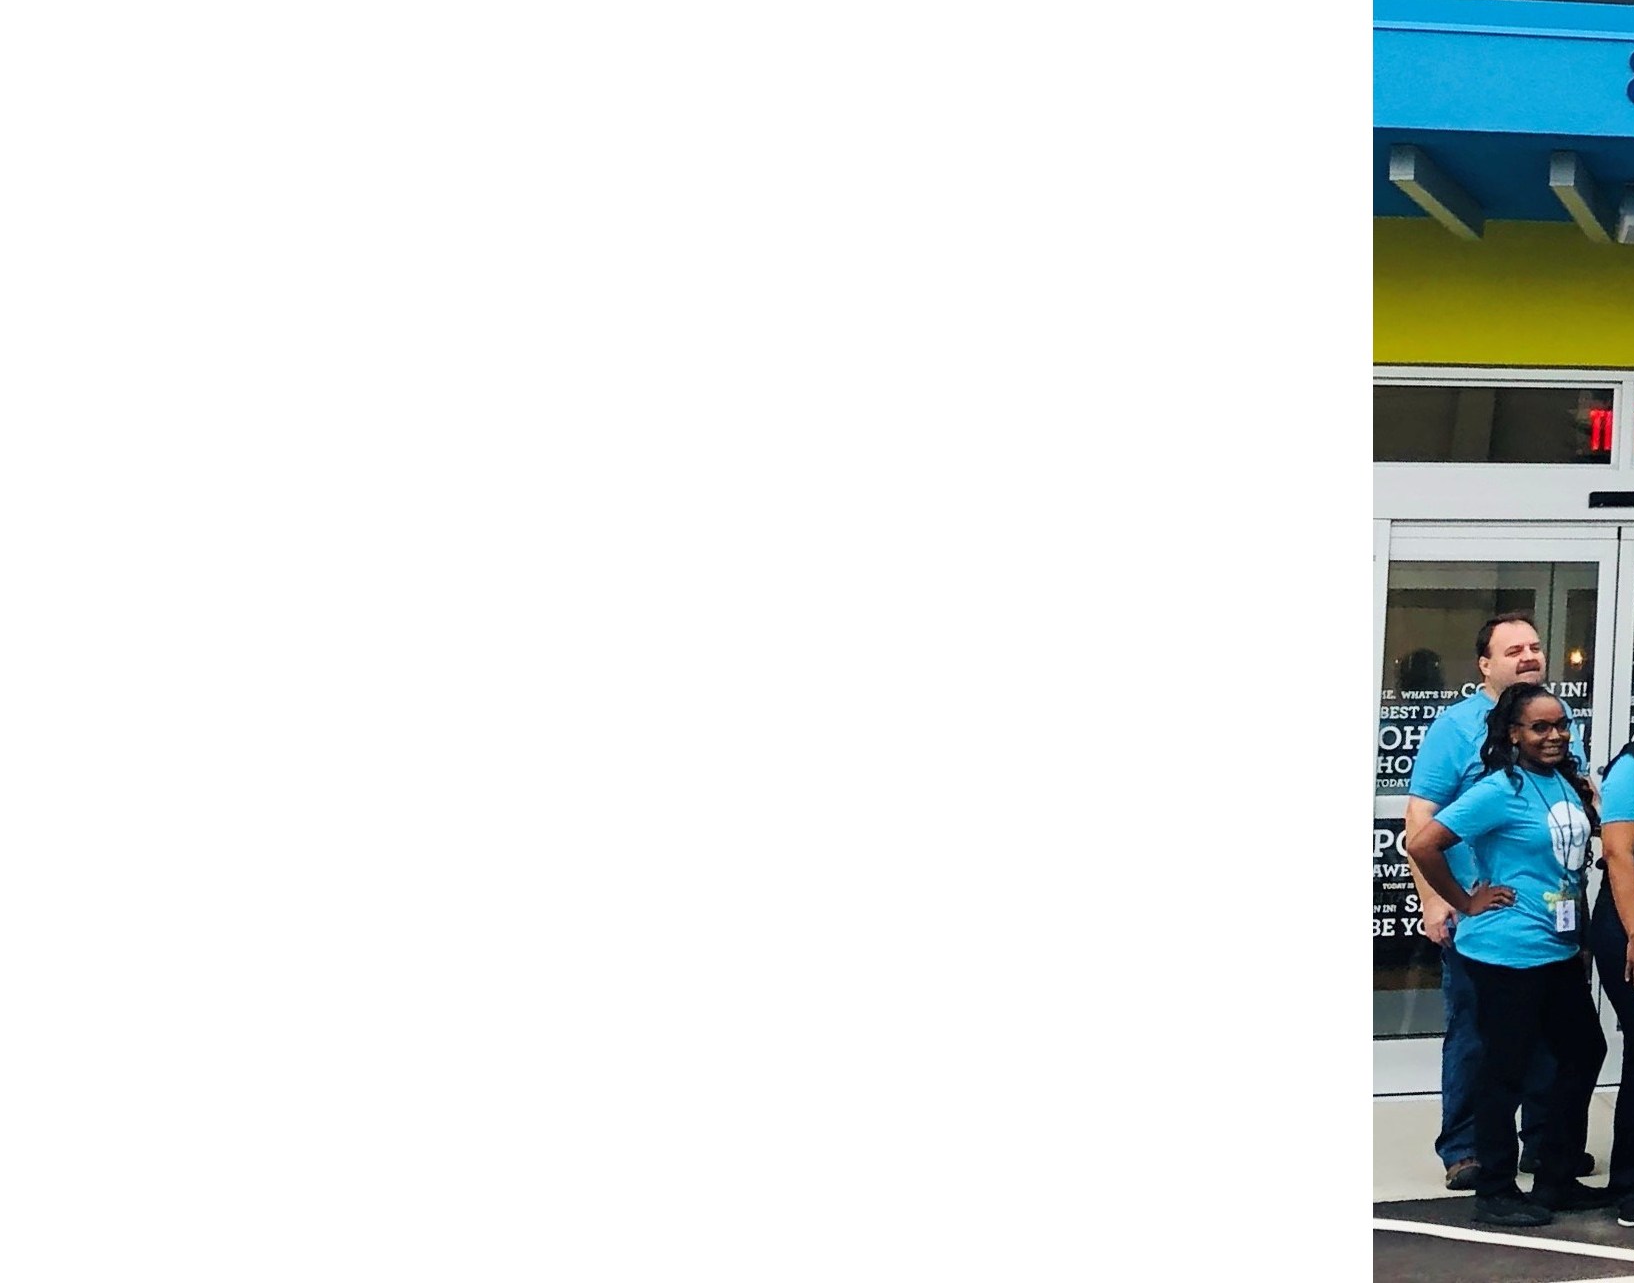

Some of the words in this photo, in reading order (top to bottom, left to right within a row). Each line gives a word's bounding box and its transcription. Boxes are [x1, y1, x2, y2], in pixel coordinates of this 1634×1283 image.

[1401, 690, 1439, 699] WHAT'S
[1441, 690, 1458, 699] UP?
[1559, 681, 1588, 697] IN!
[1380, 705, 1421, 719] BEST
[1376, 778, 1411, 788] TODAY
[1373, 917, 1396, 937] BE
